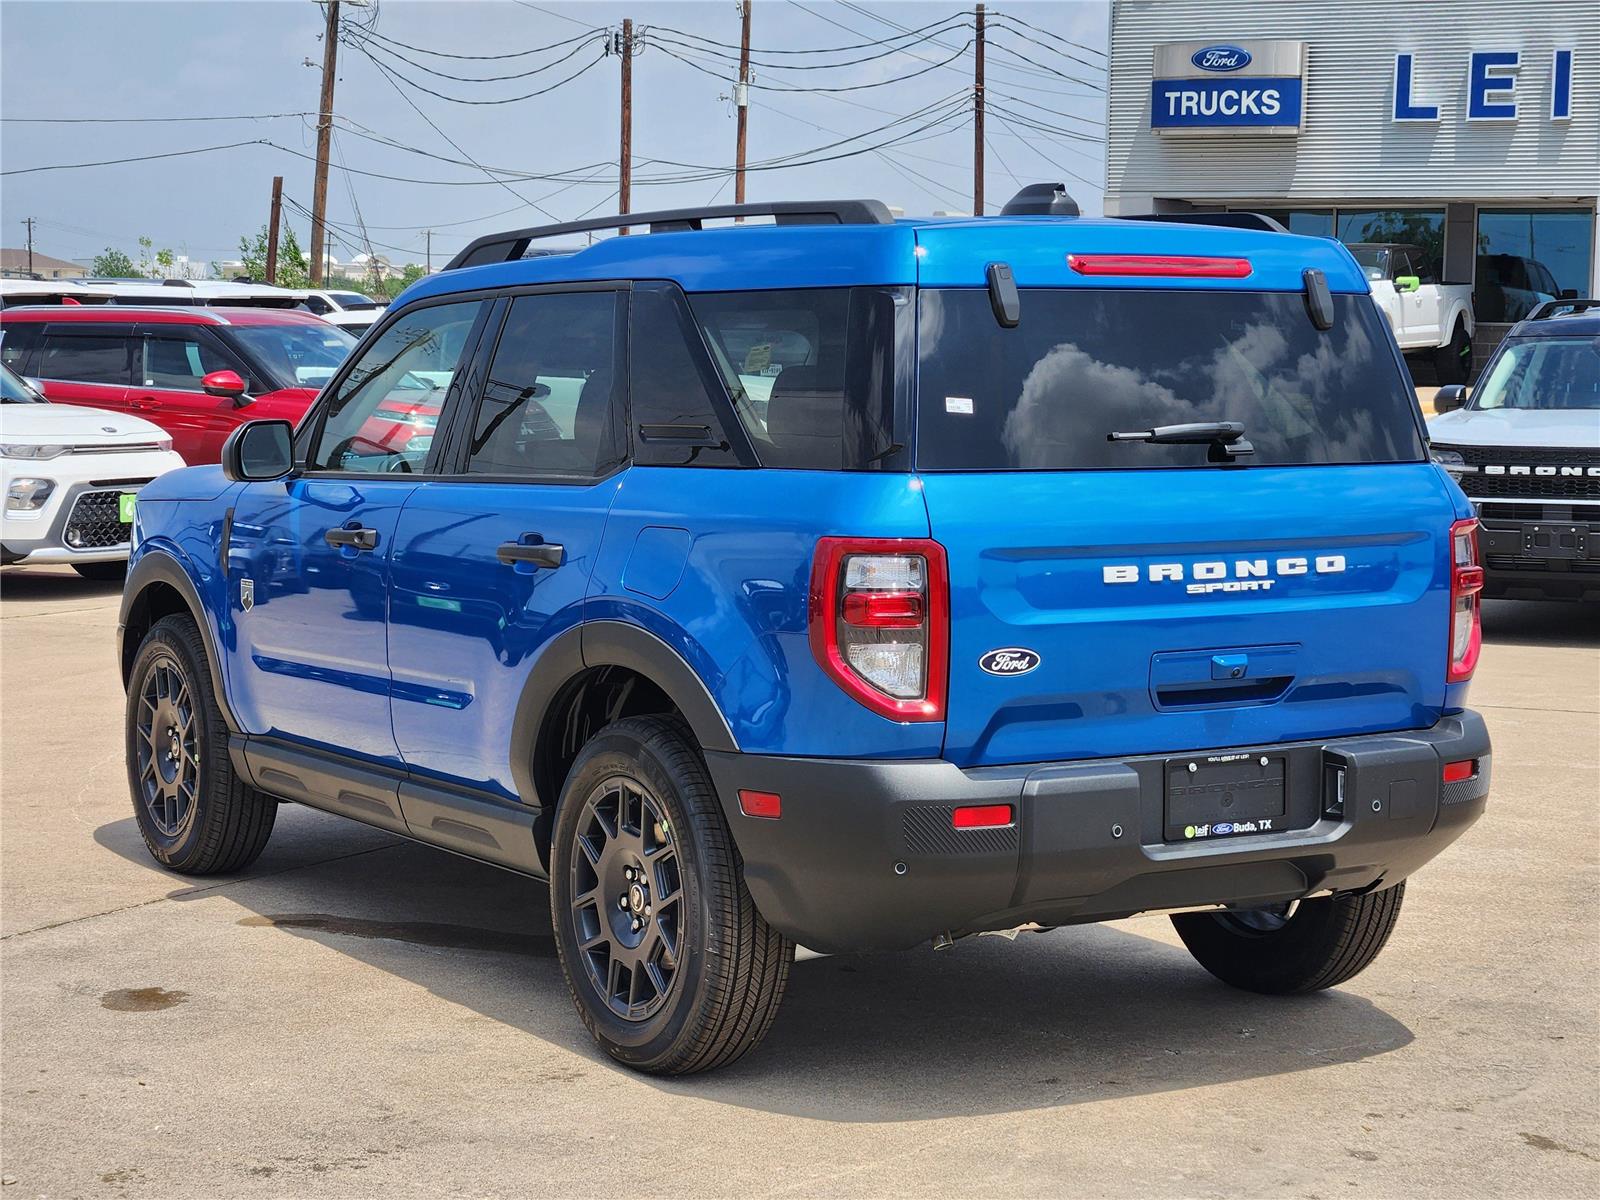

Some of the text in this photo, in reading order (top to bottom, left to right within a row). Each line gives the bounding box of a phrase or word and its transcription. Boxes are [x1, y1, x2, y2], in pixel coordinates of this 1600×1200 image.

[1202, 50, 1238, 66] Ford
[1164, 89, 1281, 116] TRUCKS
[1103, 555, 1346, 584] BRONCO
[1186, 580, 1275, 594] SPORT
[992, 652, 1030, 670] Ford
[1233, 822, 1257, 833] Buda,
[1258, 819, 1272, 830] TX
